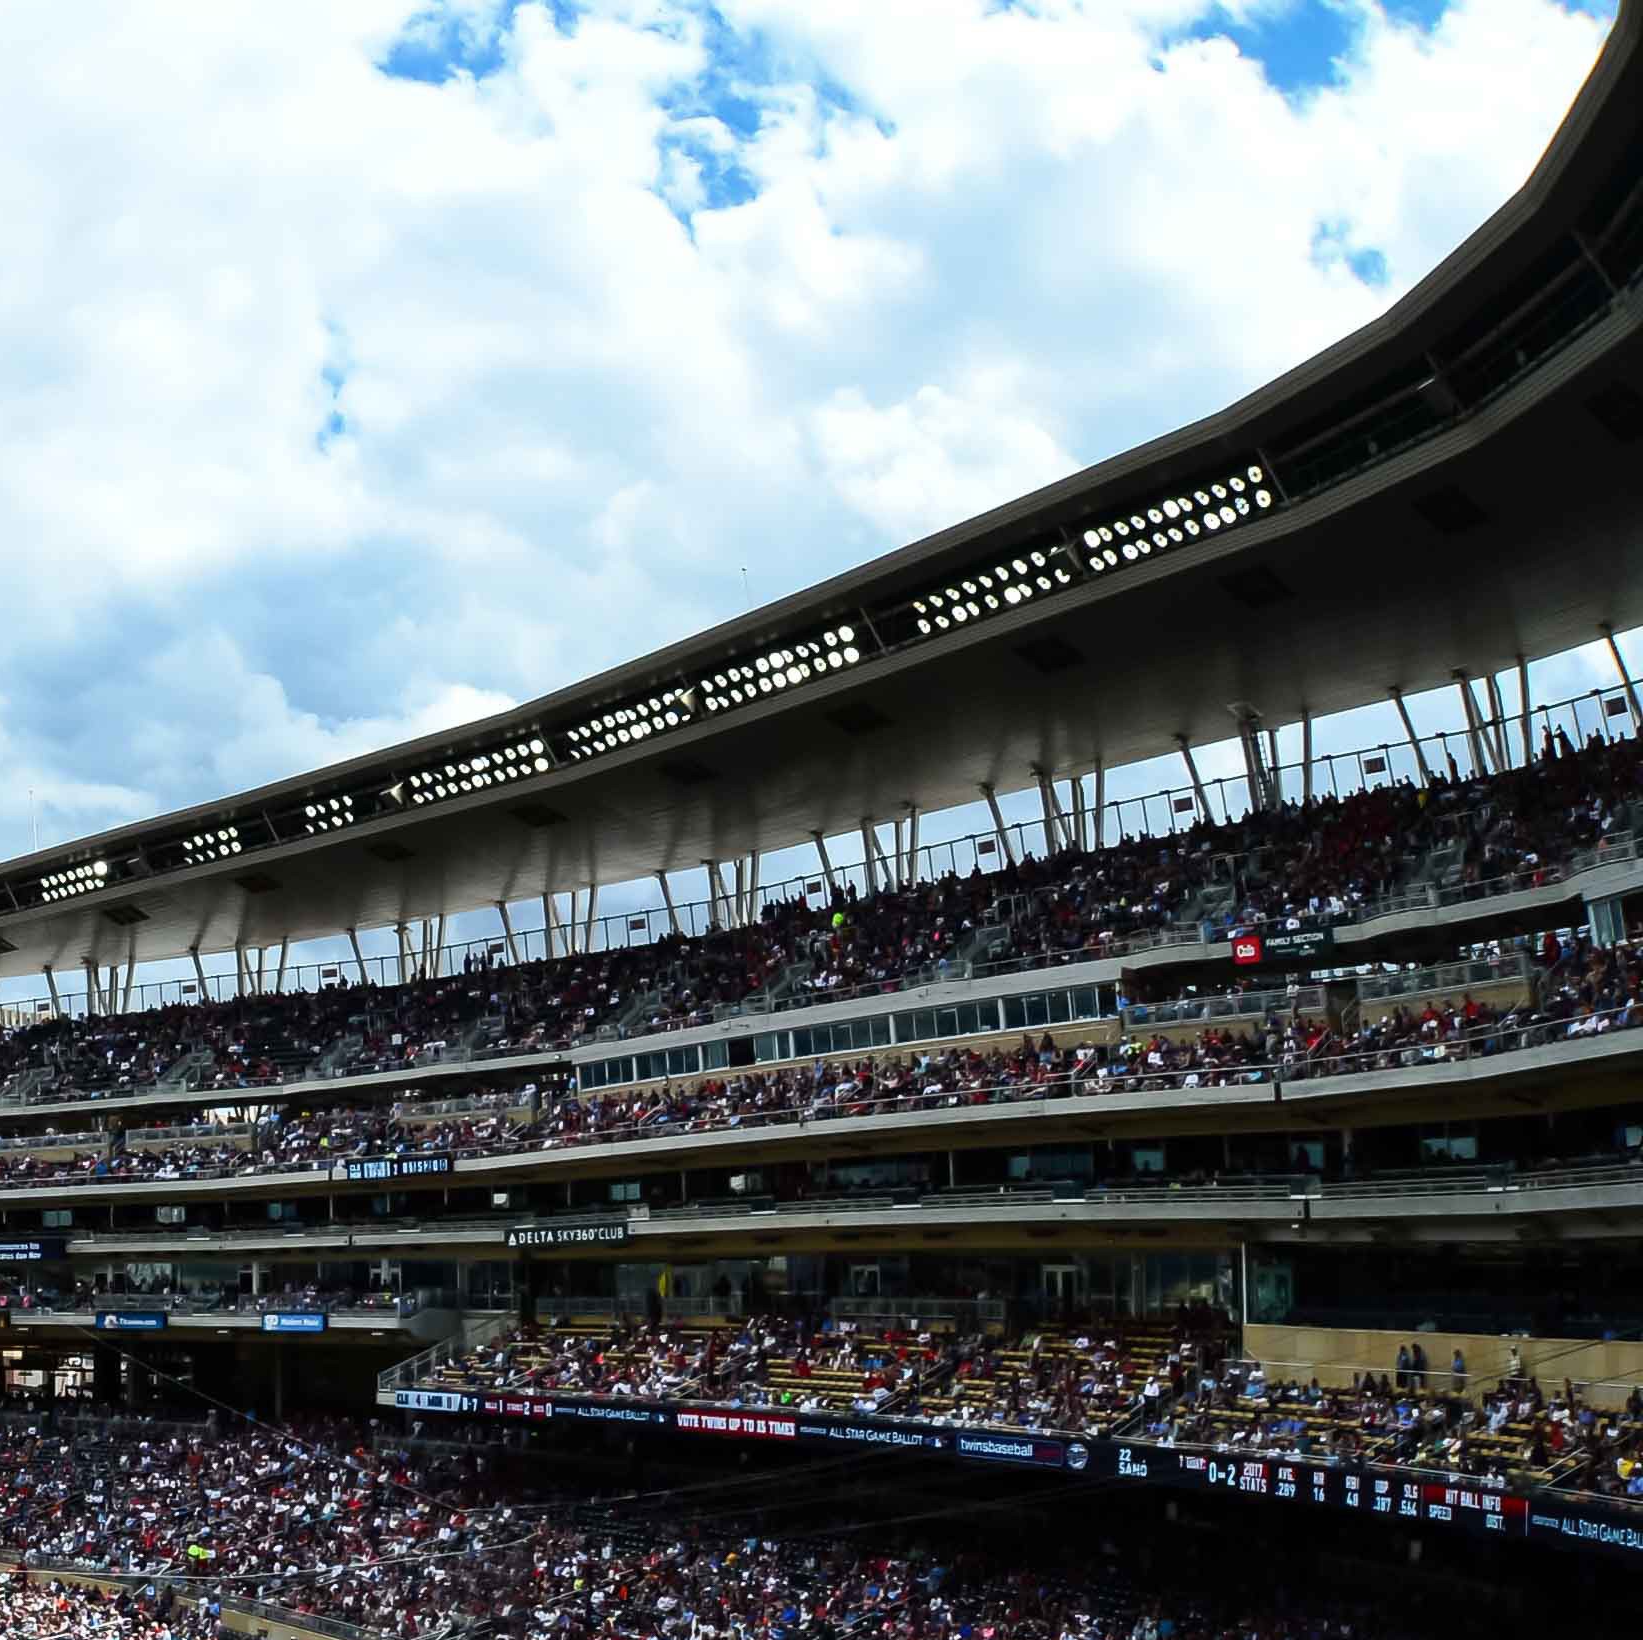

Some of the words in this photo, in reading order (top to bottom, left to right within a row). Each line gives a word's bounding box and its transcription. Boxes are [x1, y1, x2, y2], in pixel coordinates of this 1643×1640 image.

[1266, 937, 1291, 947] FAMILY
[1292, 932, 1324, 944] SECTION
[518, 1231, 554, 1245] DELTA
[598, 1226, 624, 1240] CLUB
[588, 1407, 606, 1418] STAR
[605, 1409, 625, 1419] GAME
[624, 1411, 651, 1421] BALLOT
[677, 1413, 699, 1428] VOTE
[700, 1415, 727, 1430] TWINS
[728, 1417, 739, 1431] UP
[742, 1418, 755, 1432] TO
[767, 1419, 795, 1436] TIMES
[829, 1427, 844, 1440] ALL
[844, 1428, 865, 1440] STAR
[865, 1430, 892, 1443] GAME
[891, 1432, 924, 1446] BALLOT
[960, 1438, 1034, 1458] twinsbaseball
[1119, 1448, 1132, 1461] 22
[1208, 1465, 1236, 1486] 0-2
[1243, 1461, 1264, 1476] 2017
[1239, 1476, 1267, 1494] STATS
[1274, 1482, 1296, 1498] .289
[1403, 1484, 1418, 1499] SLG
[1313, 1486, 1325, 1502] 16
[1445, 1489, 1458, 1505] HIT
[1459, 1492, 1481, 1509] BALL
[1481, 1495, 1502, 1512] INFO
[1397, 1501, 1418, 1518] .564
[1428, 1504, 1452, 1521] SPEED
[1561, 1517, 1577, 1535] ALL
[1577, 1520, 1599, 1539] STAR
[1598, 1523, 1627, 1544] GAME
